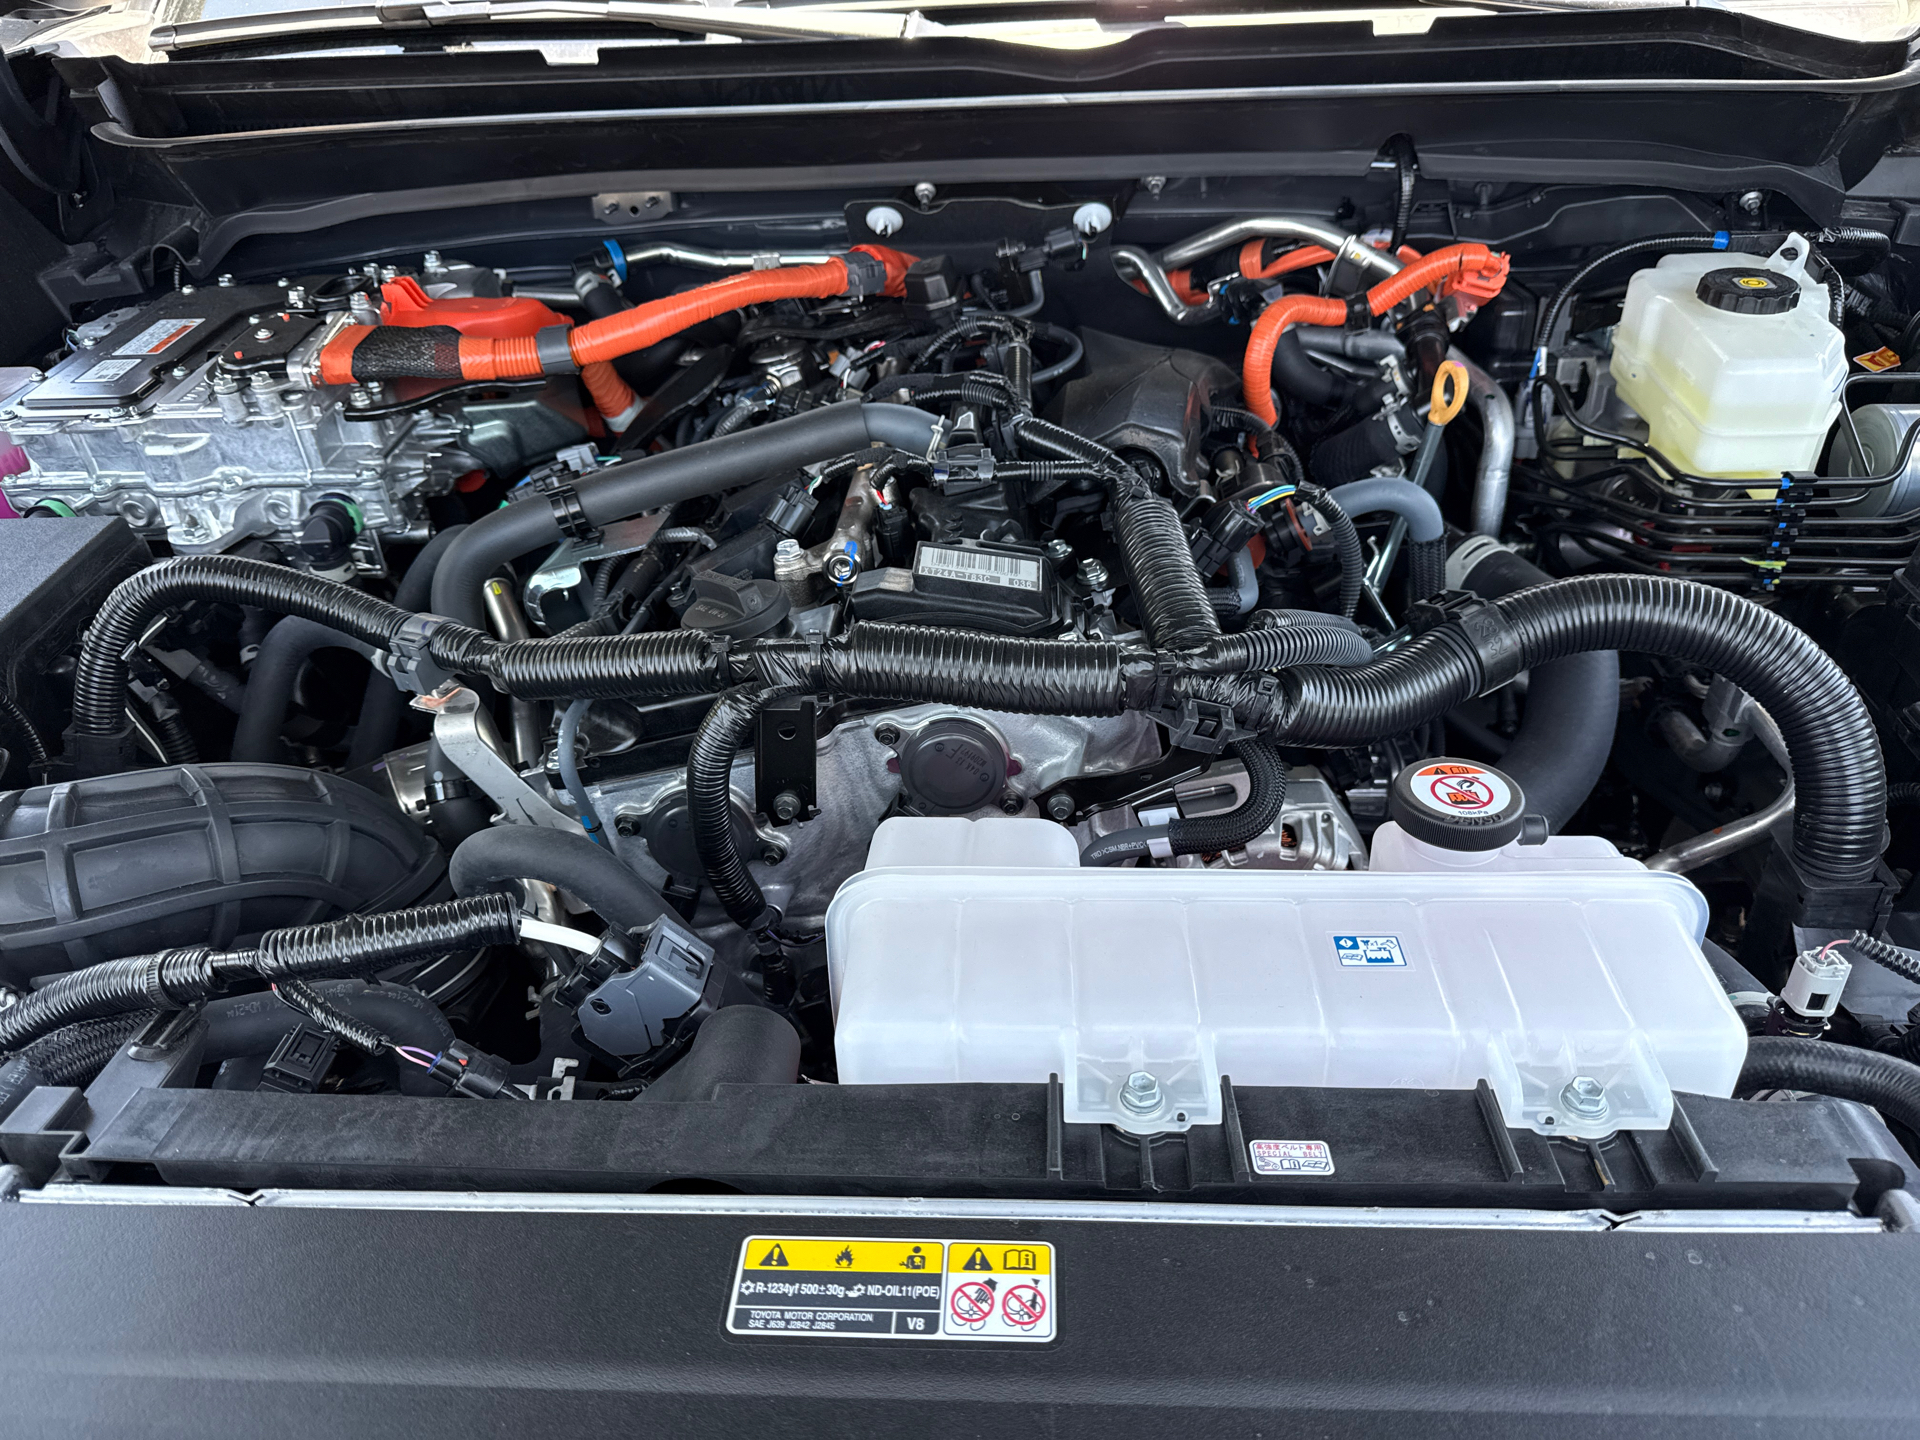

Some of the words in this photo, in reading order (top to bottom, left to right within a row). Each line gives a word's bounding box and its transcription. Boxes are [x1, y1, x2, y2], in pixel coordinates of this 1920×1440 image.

[923, 566, 991, 583] XT24A-T83C
[1013, 579, 1033, 588] 036
[1443, 813, 1504, 826] DENSO
[756, 1282, 800, 1297] R-1234yf
[800, 1283, 845, 1298] 500±30g
[867, 1284, 940, 1299] ND-OIL11(POE)
[749, 1310, 782, 1319] TOYOTA
[784, 1311, 814, 1320] MOTOR
[815, 1312, 873, 1322] CORPORATION
[748, 1319, 766, 1329] SAE
[766, 1320, 786, 1329] J639
[787, 1320, 811, 1330] J2842
[812, 1321, 837, 1330] J2845
[906, 1317, 926, 1331] V8
